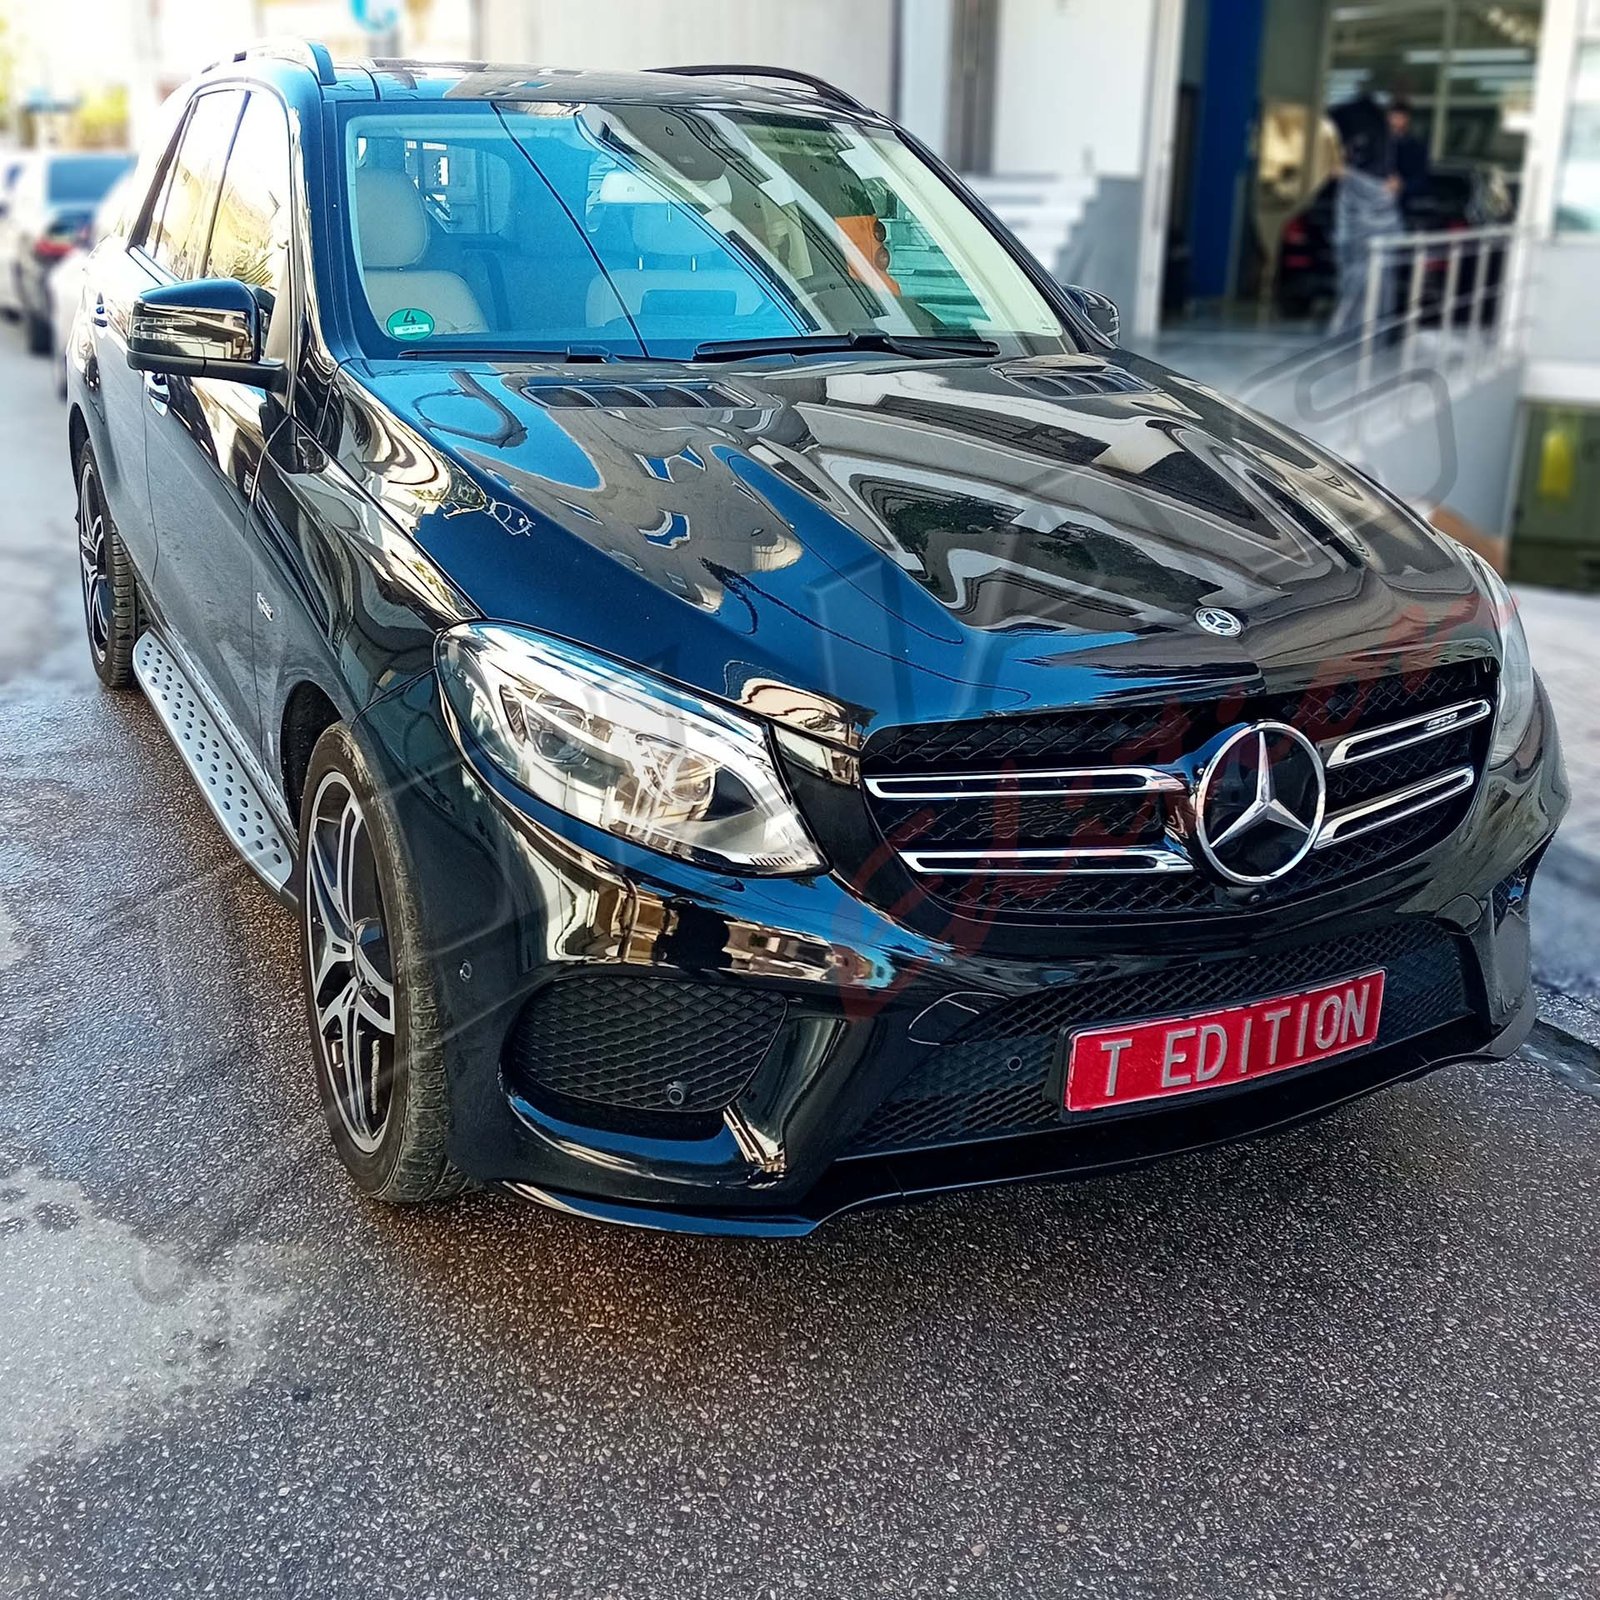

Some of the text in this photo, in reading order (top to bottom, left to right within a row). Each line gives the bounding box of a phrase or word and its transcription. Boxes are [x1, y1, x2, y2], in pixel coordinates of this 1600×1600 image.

[403, 310, 417, 325] 4
[1100, 983, 1371, 1097] T EDITION
